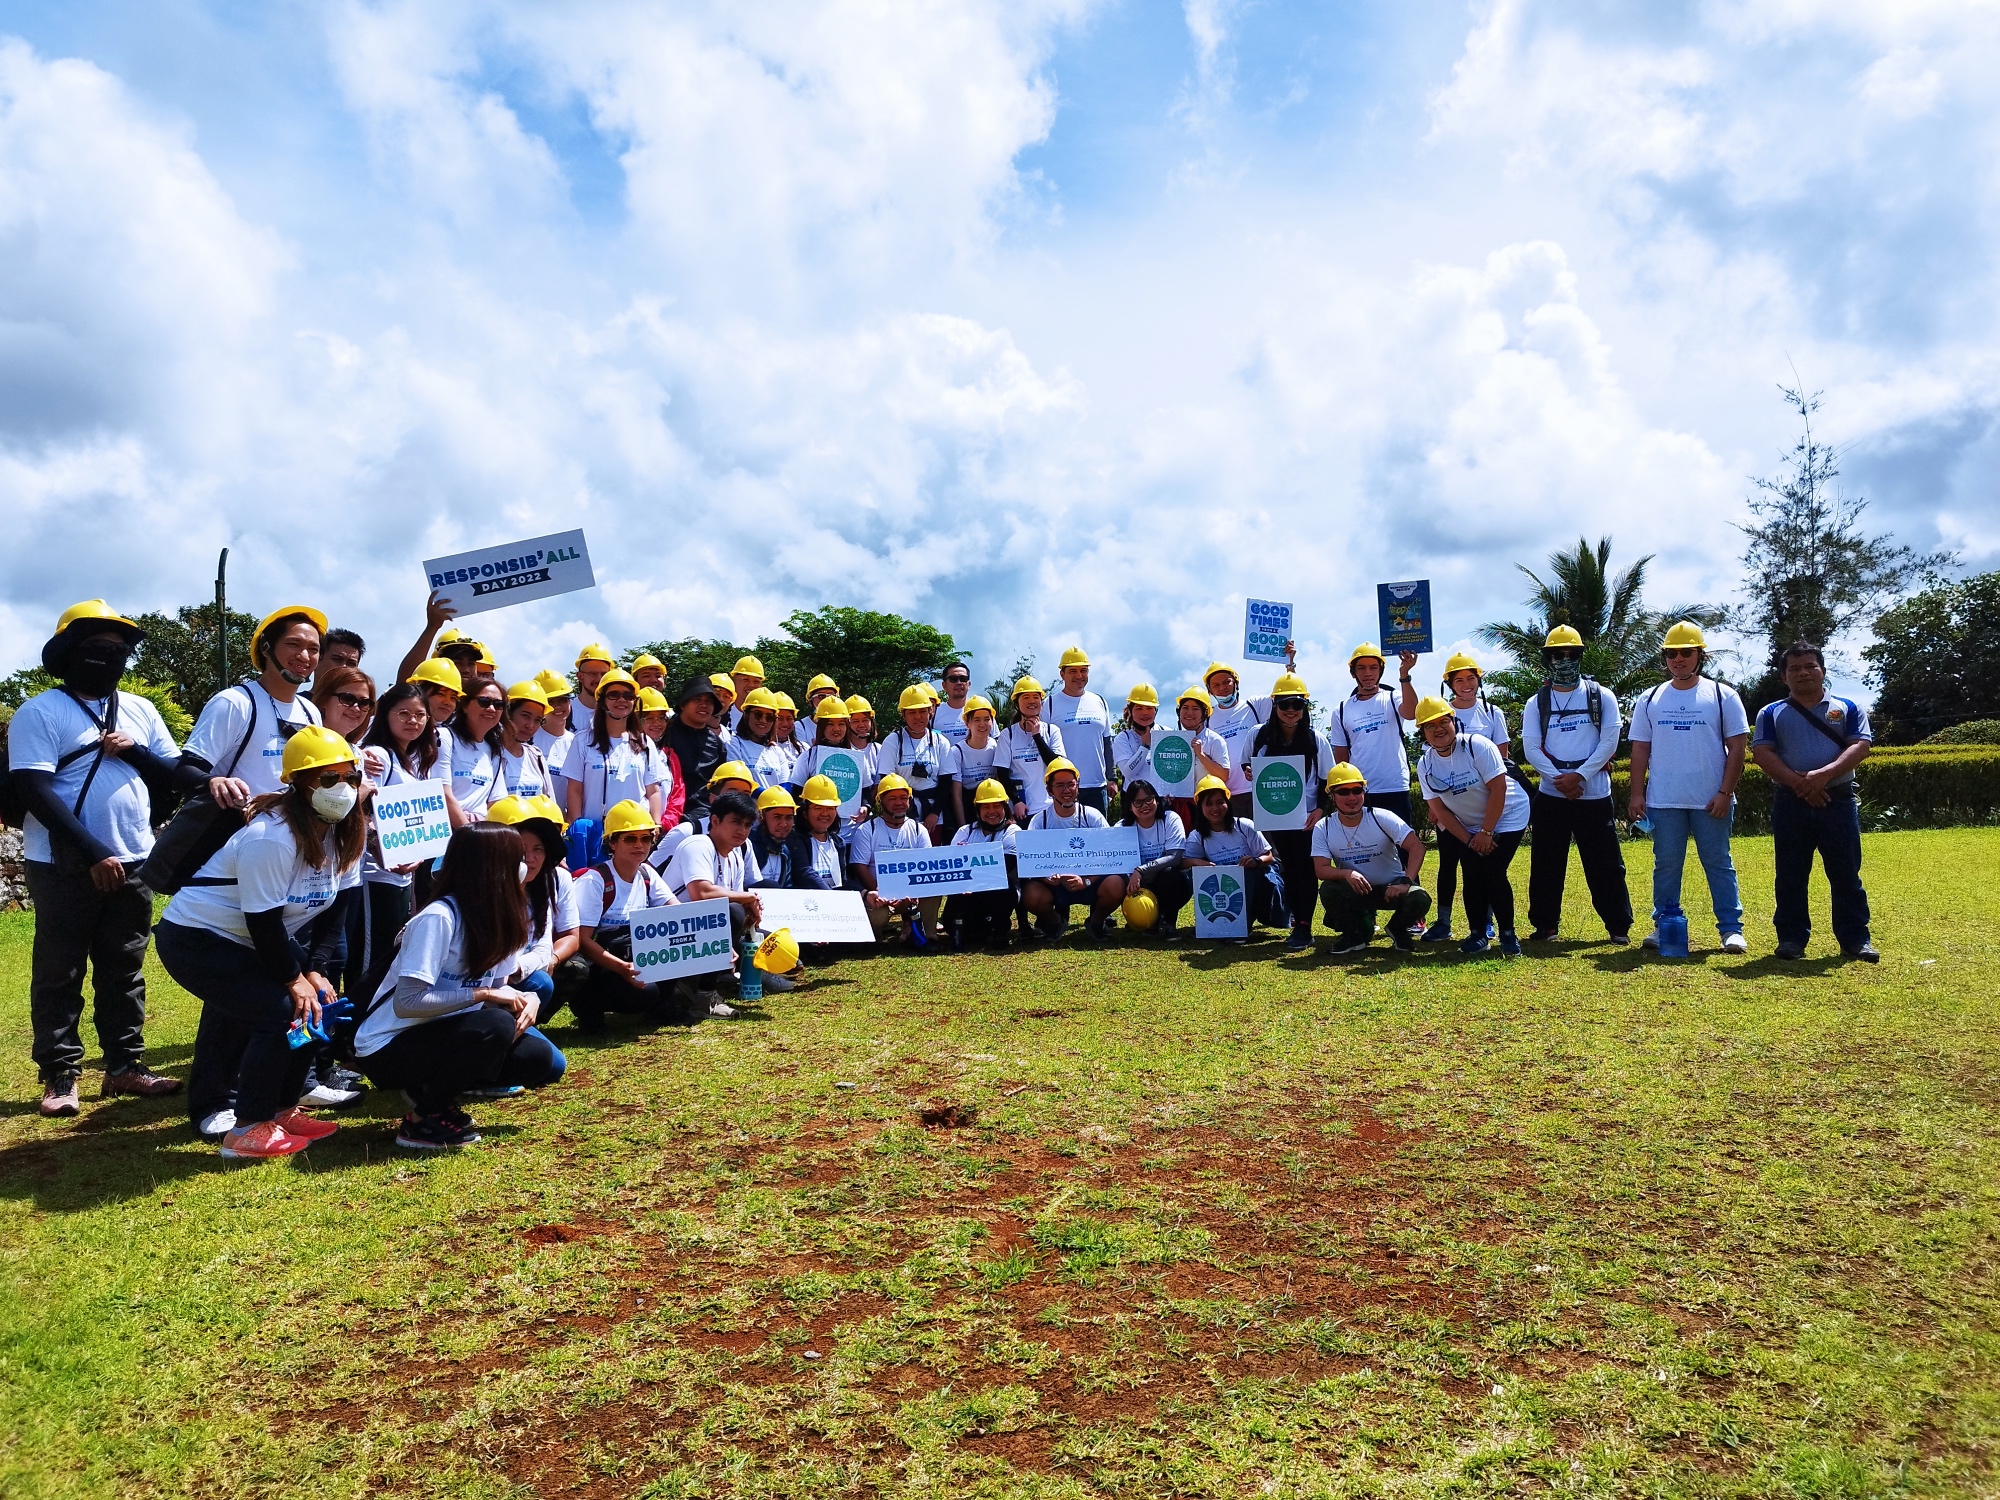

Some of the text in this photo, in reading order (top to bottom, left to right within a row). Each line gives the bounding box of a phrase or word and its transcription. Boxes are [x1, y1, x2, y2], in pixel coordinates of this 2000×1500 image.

[429, 546, 581, 588] RESPONSIB'ALL
[481, 572, 542, 592] DAY 2022
[1250, 602, 1290, 618] GOOD
[1250, 614, 1289, 629] TIMES
[1248, 632, 1288, 647] GOOD
[1248, 643, 1287, 658] PLACE
[824, 769, 855, 779] TERROIR
[1261, 780, 1297, 789] TERROIR
[377, 795, 444, 820] GOOD TIMES
[382, 821, 451, 850] GOOD PLACE
[1019, 851, 1051, 859] Pernod
[1053, 850, 1084, 859] Ricard
[1086, 849, 1138, 858] Philippines
[877, 855, 999, 875] RESPONSIB'ALL
[916, 872, 965, 883] DAY 2022
[634, 912, 728, 941] GOOD TIMES
[672, 937, 688, 945] FROM
[635, 938, 730, 968] GOOD PLACE
